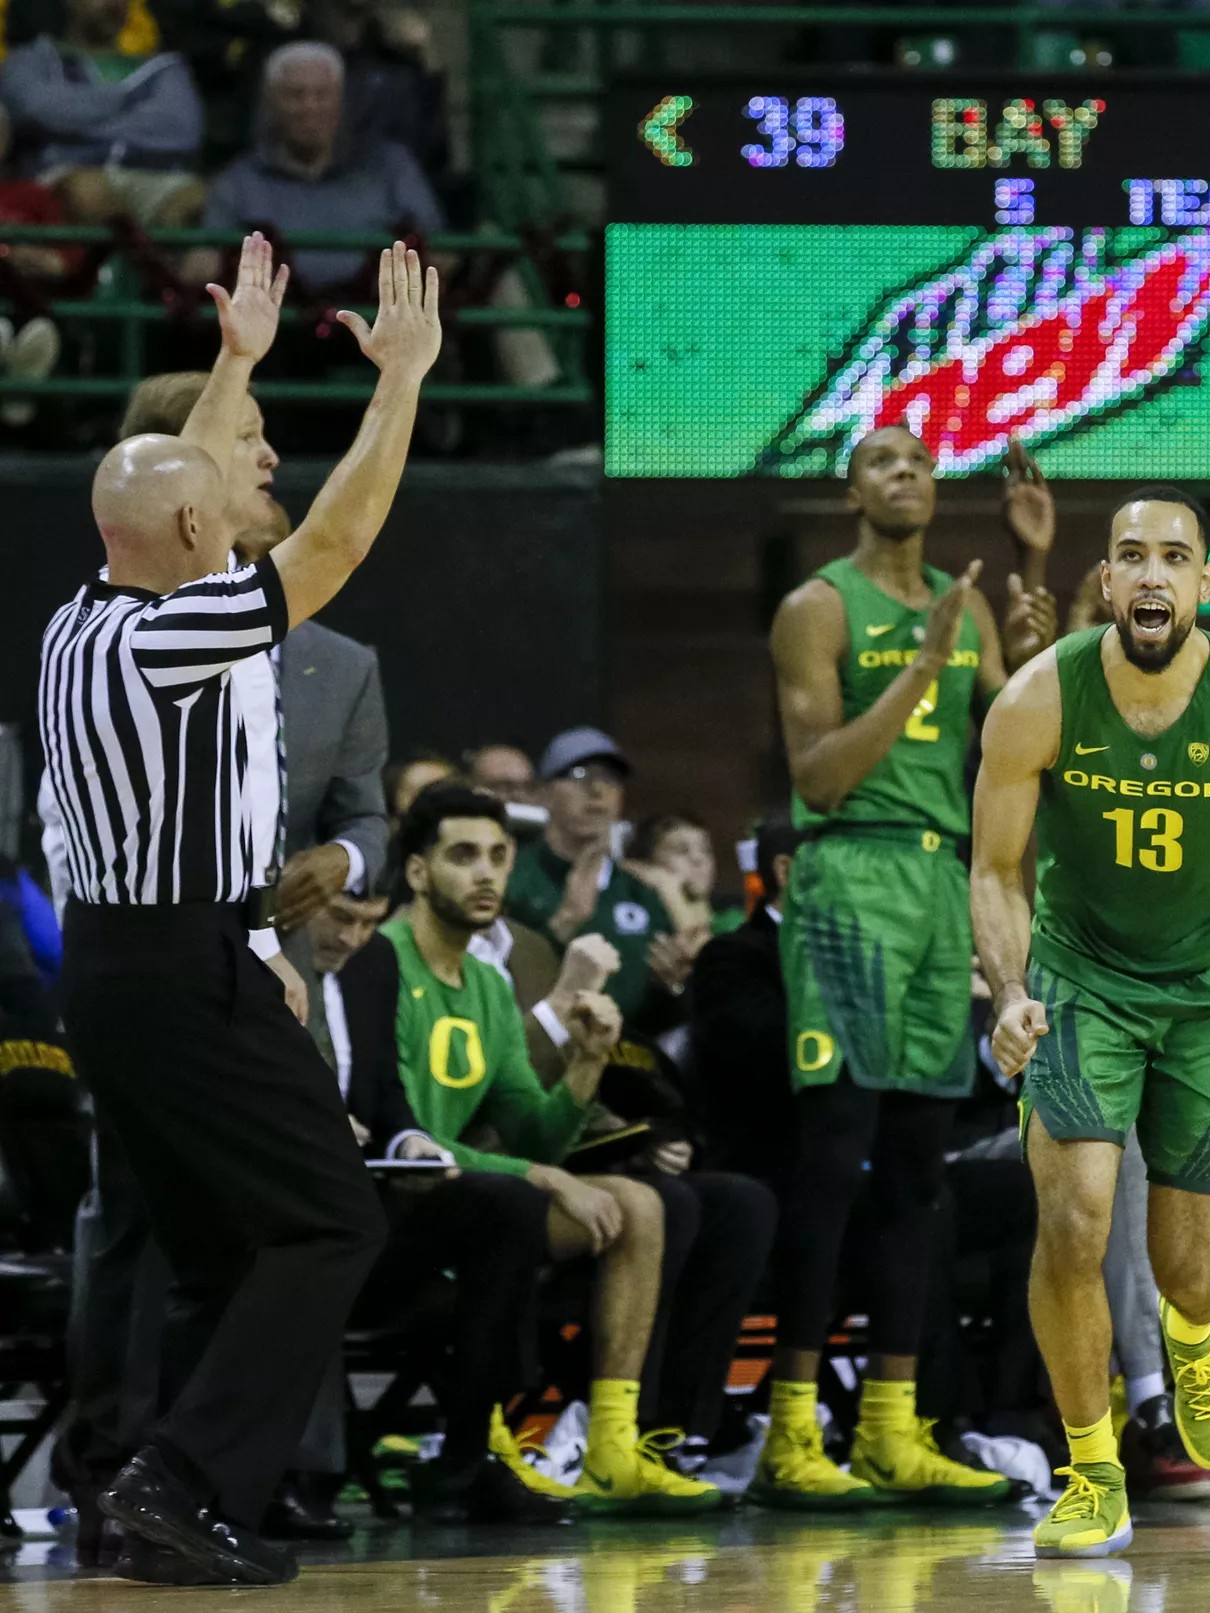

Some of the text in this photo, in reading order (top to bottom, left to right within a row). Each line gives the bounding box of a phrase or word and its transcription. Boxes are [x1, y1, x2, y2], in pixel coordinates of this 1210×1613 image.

[742, 95, 844, 167] 39
[932, 97, 1106, 168] BAY
[858, 650, 980, 668] OREON
[1101, 807, 1184, 873] 13
[429, 1017, 487, 1089] O
